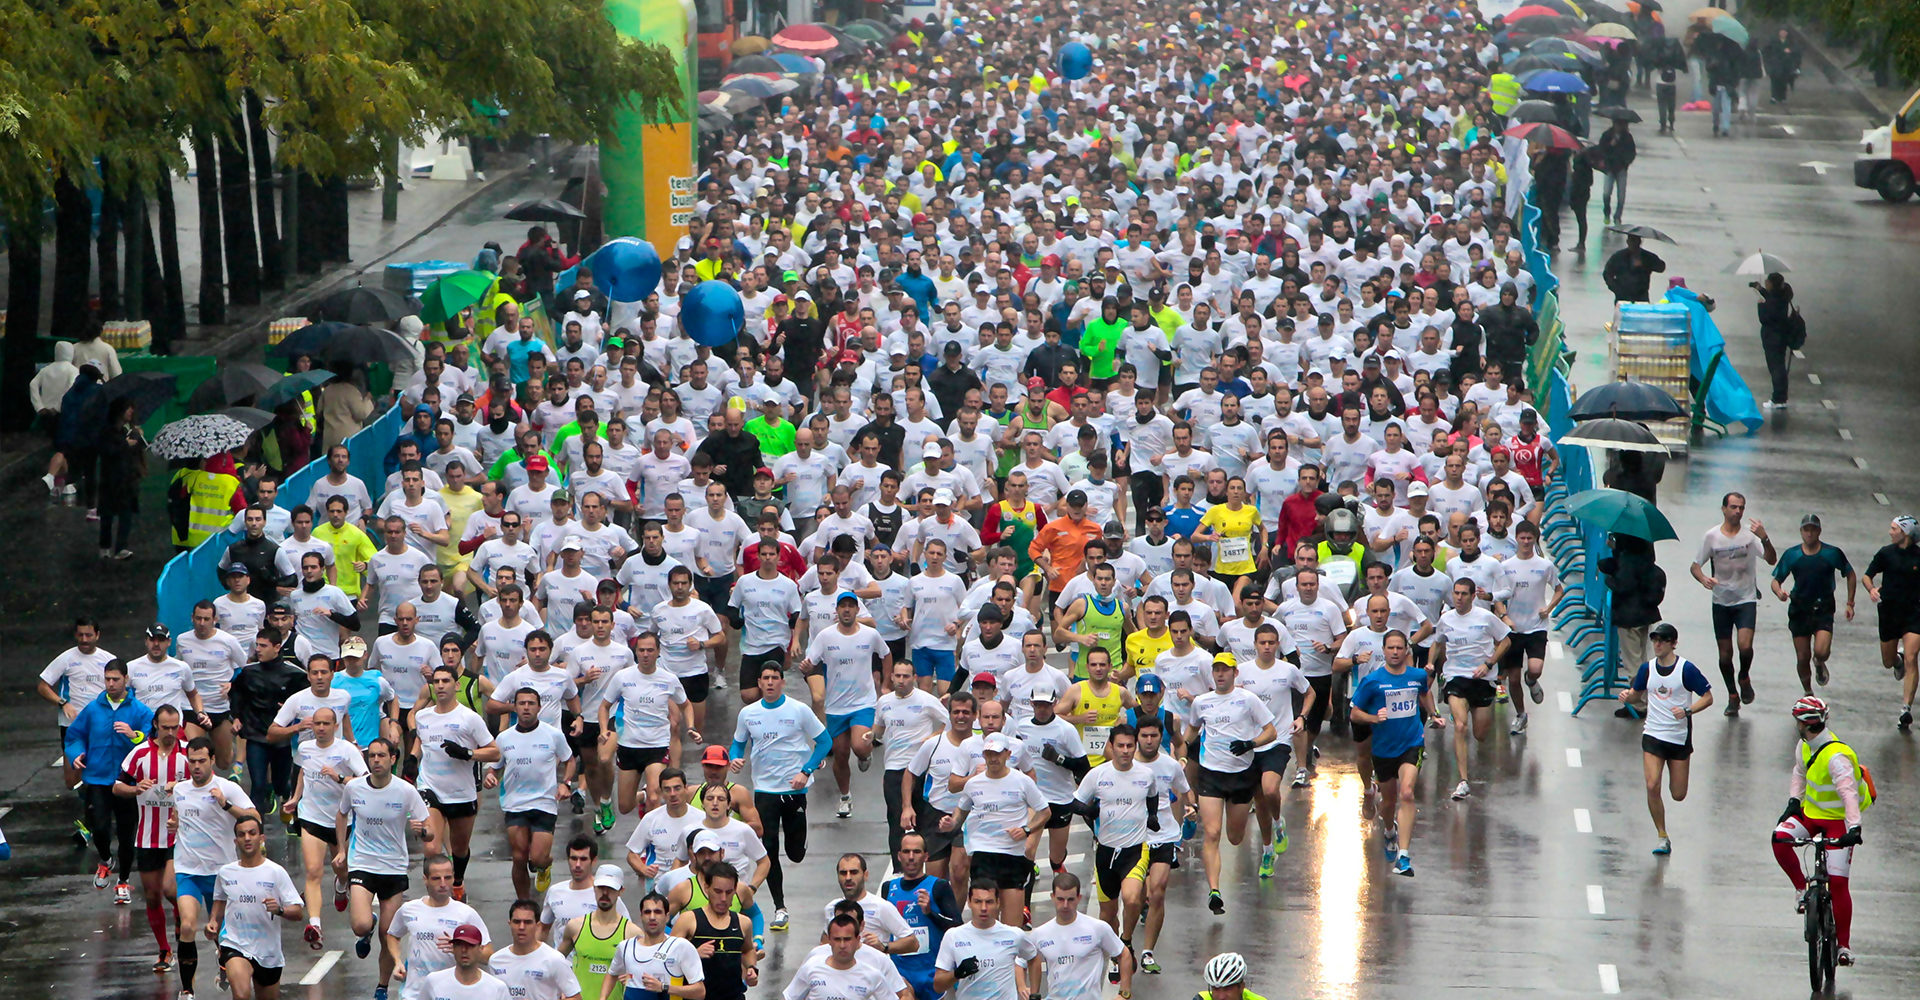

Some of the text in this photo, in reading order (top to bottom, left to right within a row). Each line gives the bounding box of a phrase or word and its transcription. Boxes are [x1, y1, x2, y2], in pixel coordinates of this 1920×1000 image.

[1223, 548, 1245, 557] 14817
[1391, 700, 1414, 712] 3467
[240, 895, 256, 903] 03901
[416, 931, 434, 940] 00689
[1058, 954, 1074, 965] 02717
[591, 964, 607, 972] 2125
